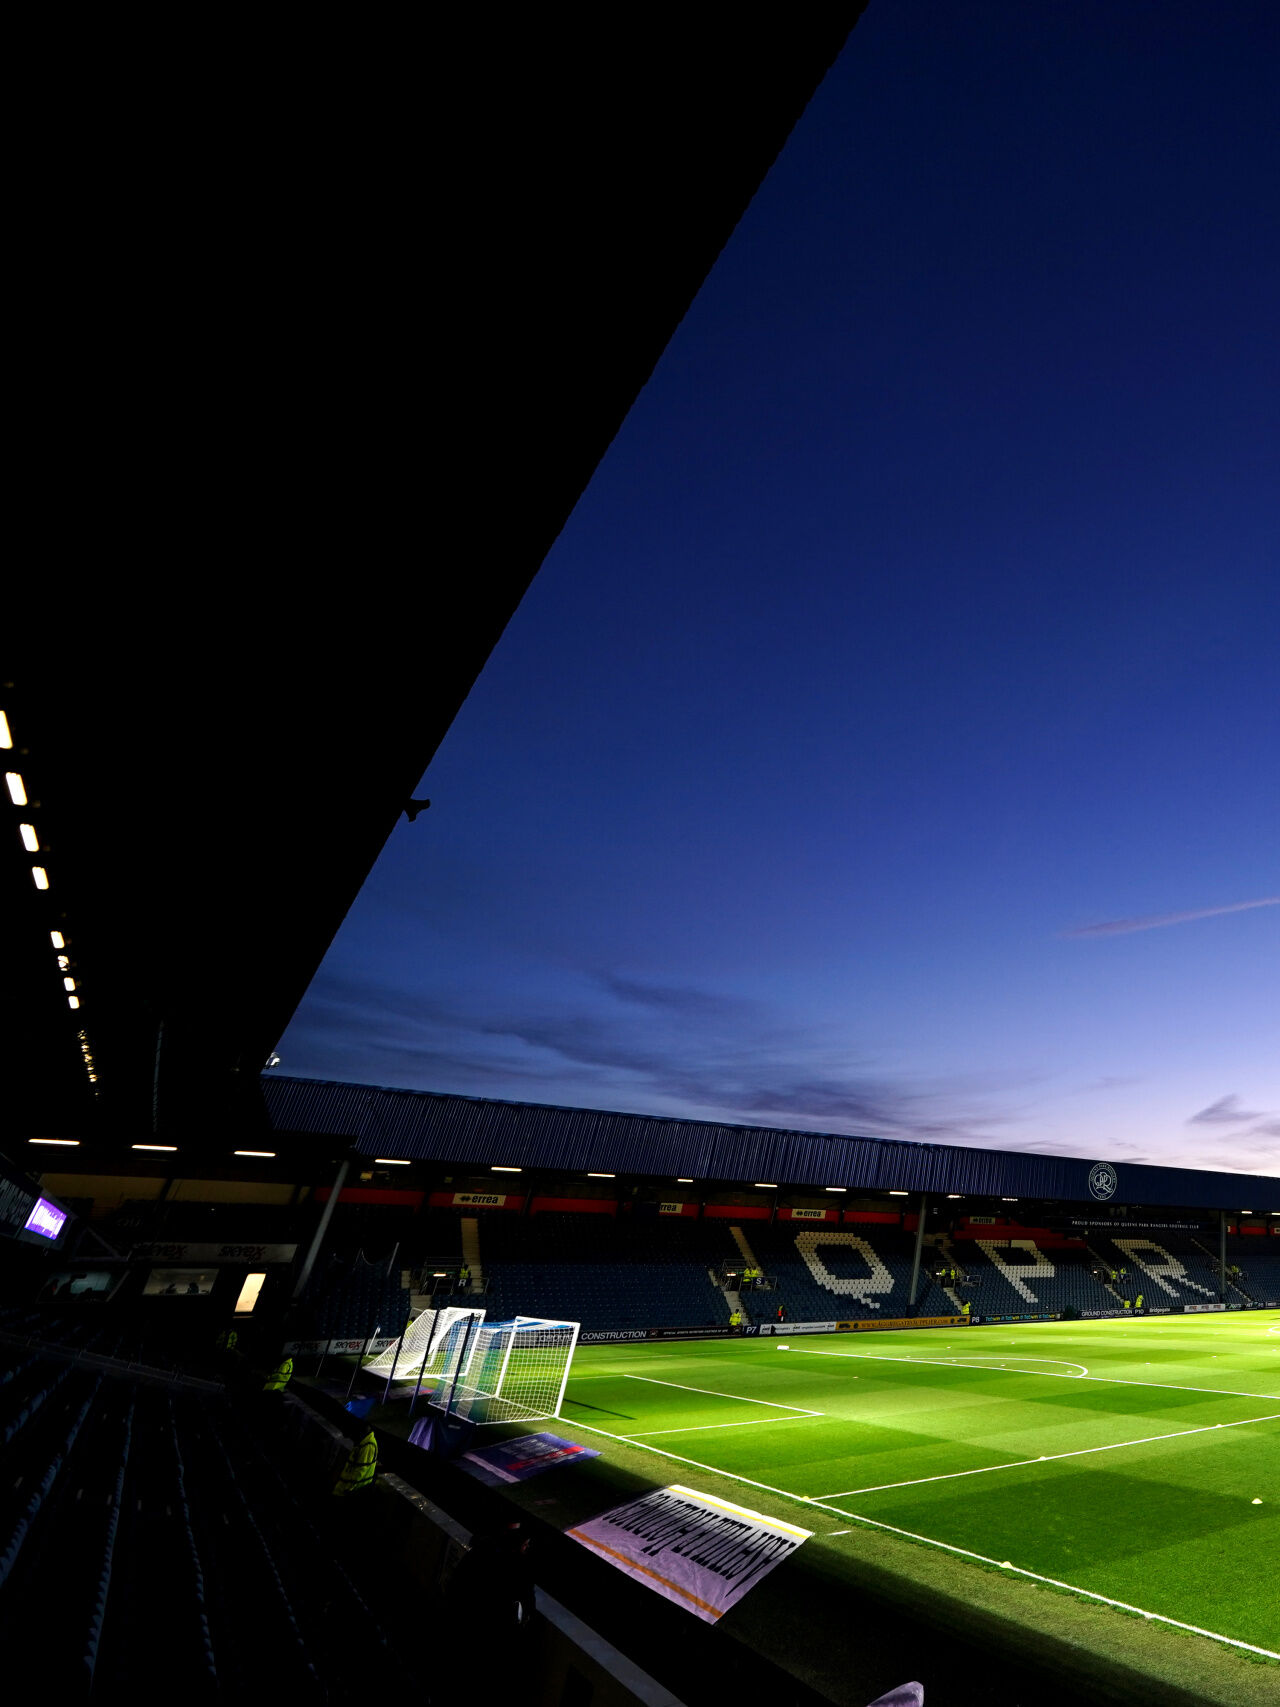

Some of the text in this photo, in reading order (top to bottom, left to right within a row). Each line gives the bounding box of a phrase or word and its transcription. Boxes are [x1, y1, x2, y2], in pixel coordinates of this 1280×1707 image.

[472, 1195, 499, 1204] errea
[794, 1231, 895, 1309] Q
[975, 1239, 1055, 1304] P
[1111, 1238, 1216, 1298] R
[581, 1331, 647, 1341] CONSTRUCTION
[746, 1326, 757, 1334] P7
[671, 1517, 797, 1598] ASHVILLE
